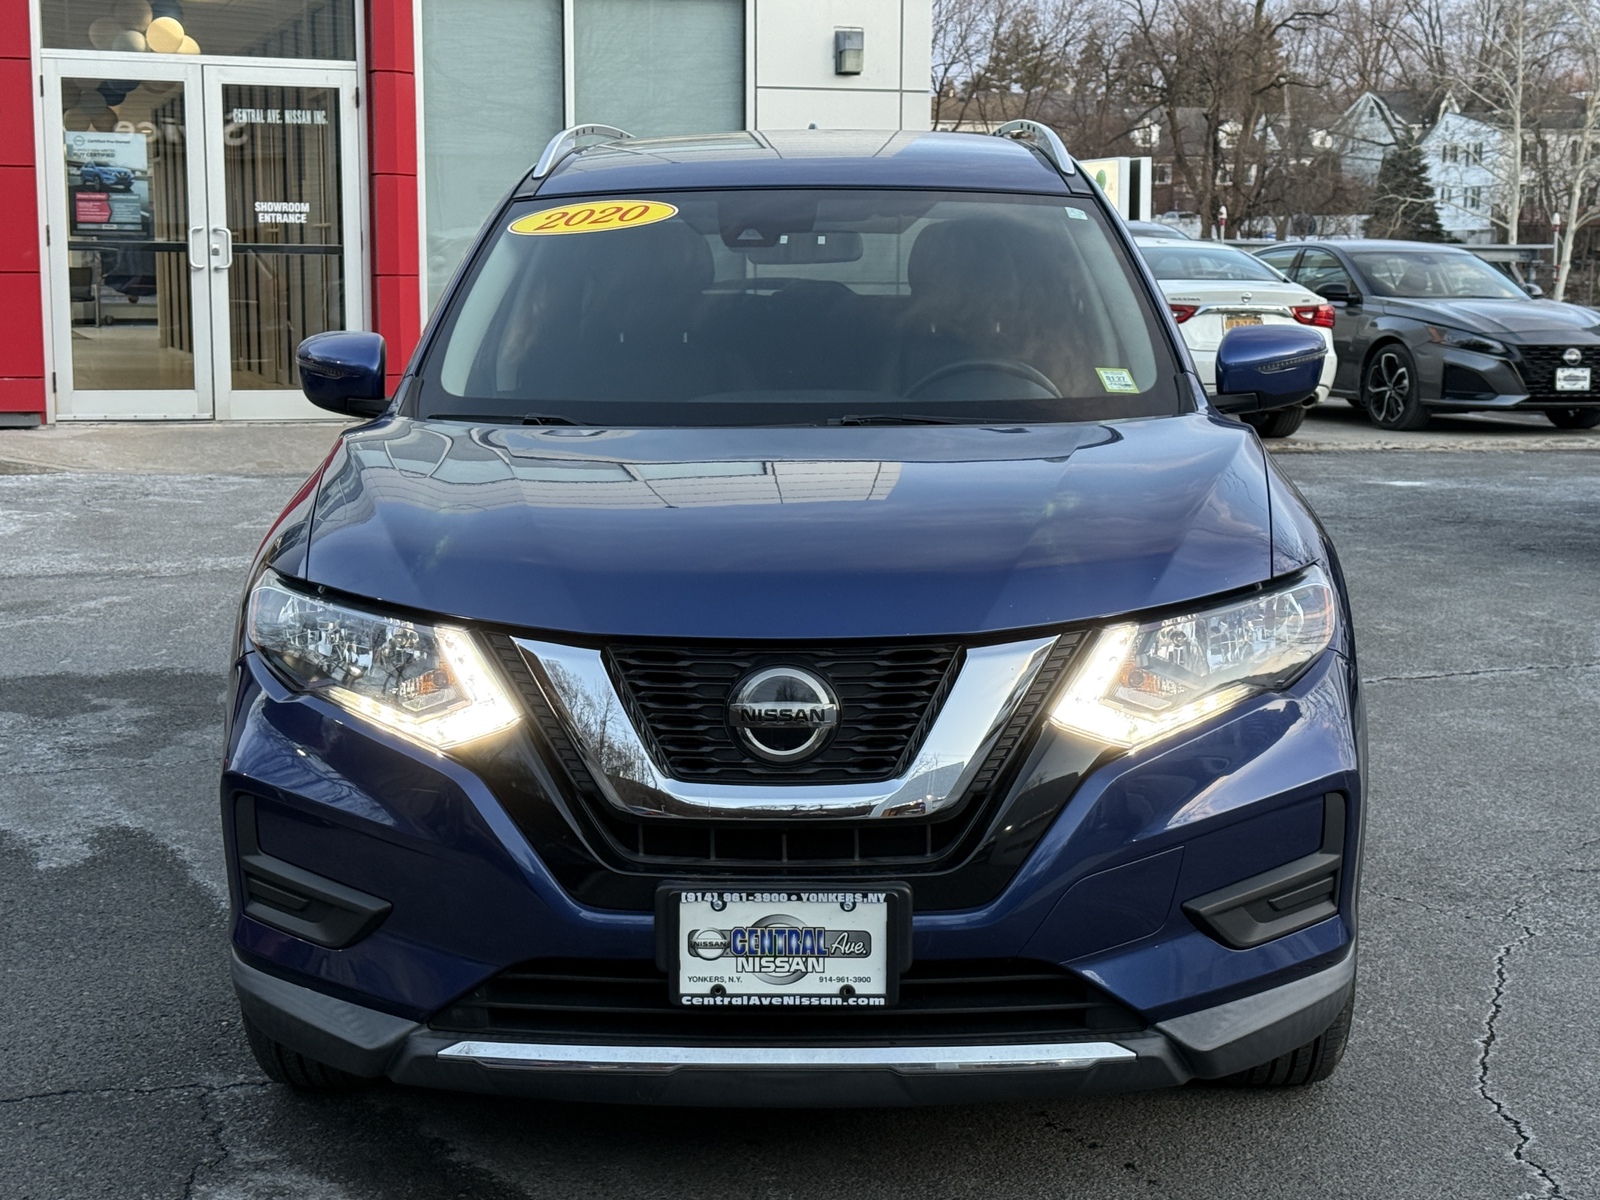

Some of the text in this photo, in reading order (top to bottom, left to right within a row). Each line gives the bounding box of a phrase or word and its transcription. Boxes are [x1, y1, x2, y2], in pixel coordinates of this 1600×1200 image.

[233, 108, 329, 124] CENTRAL AVE. NISSAN INC.
[254, 202, 310, 212] SHOWROOM
[258, 213, 307, 223] ENTRANCE
[533, 205, 650, 231] 2020
[740, 708, 825, 722] NISSAN
[723, 892, 787, 903] 961-3900
[693, 940, 727, 948] NISSAN
[730, 927, 867, 957] CENTRAL Ave.
[736, 957, 825, 973] NISSAN
[687, 976, 727, 984] YONKERS,
[681, 996, 885, 1006] CentralAveNissan.com
